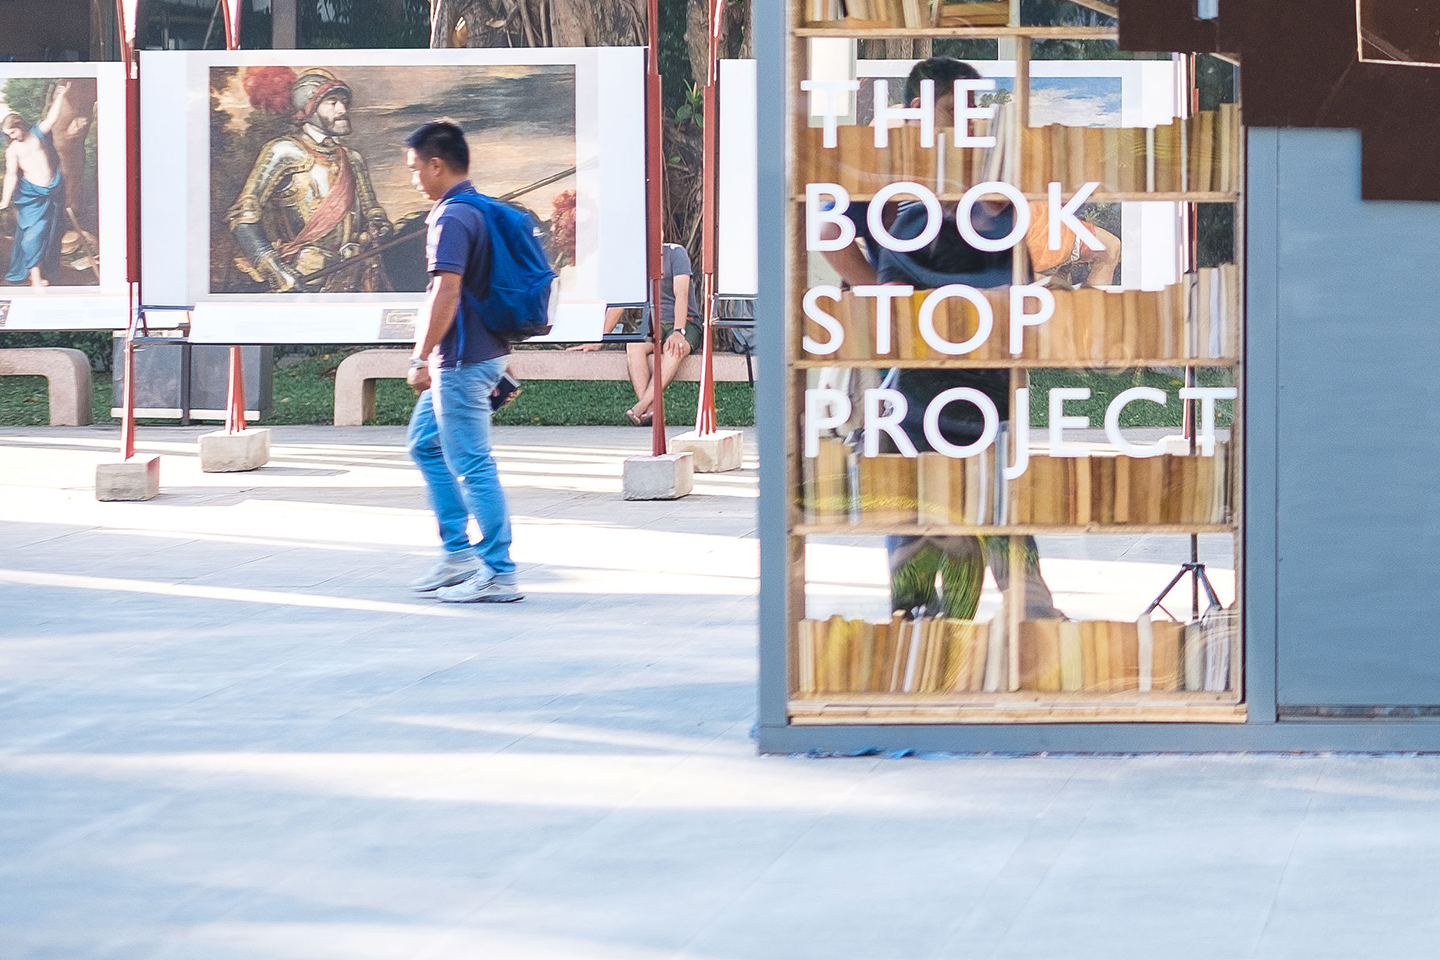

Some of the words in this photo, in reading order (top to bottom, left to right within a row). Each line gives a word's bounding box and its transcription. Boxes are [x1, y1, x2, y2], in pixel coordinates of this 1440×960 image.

[801, 79, 997, 148] THE
[805, 181, 1107, 253] BOOK
[802, 284, 1056, 356] STOP
[804, 387, 1238, 481] PROJECT
